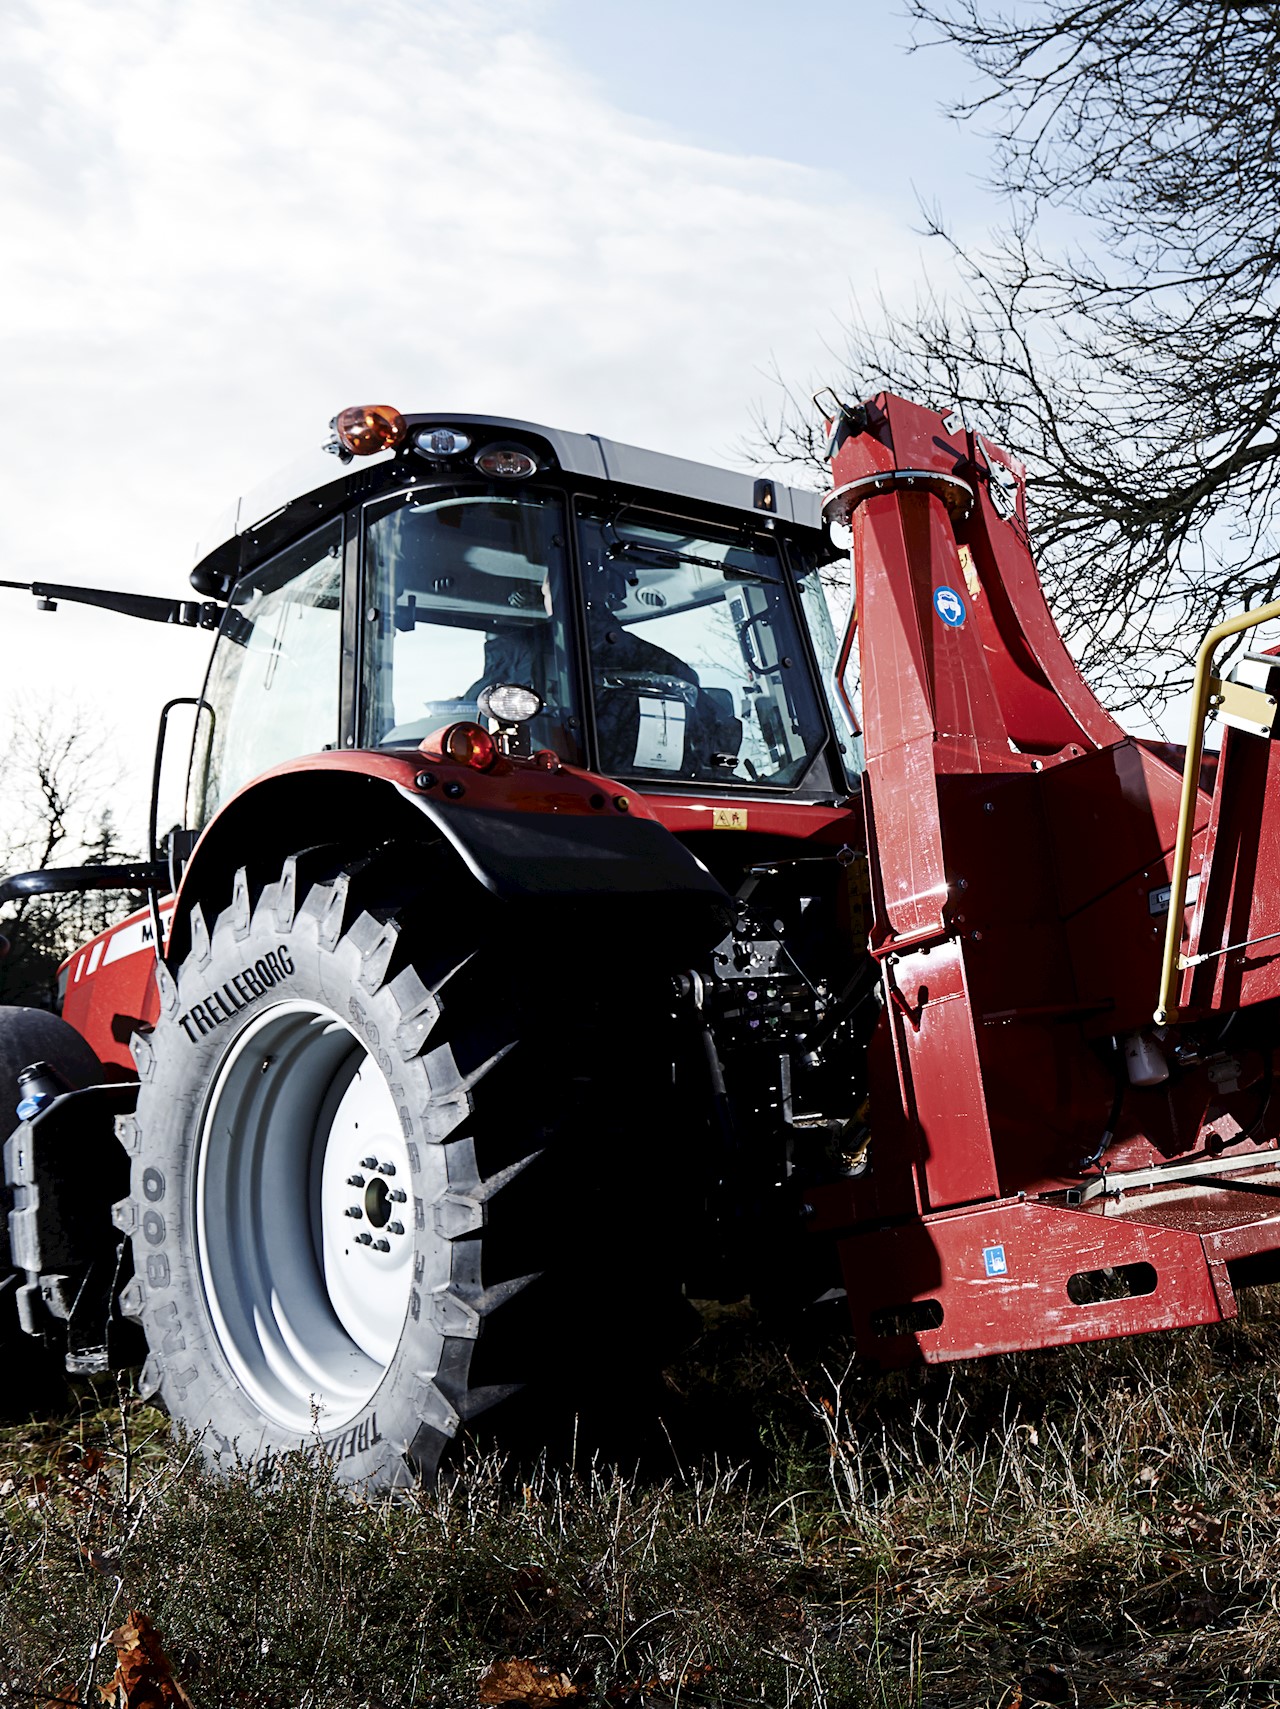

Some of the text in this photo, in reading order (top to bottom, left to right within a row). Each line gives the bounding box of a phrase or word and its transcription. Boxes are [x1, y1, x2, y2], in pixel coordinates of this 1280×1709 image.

[178, 945, 295, 1043] TRELLEBORG
[142, 1167, 171, 1290] 800
[253, 1411, 382, 1489] TRELL
